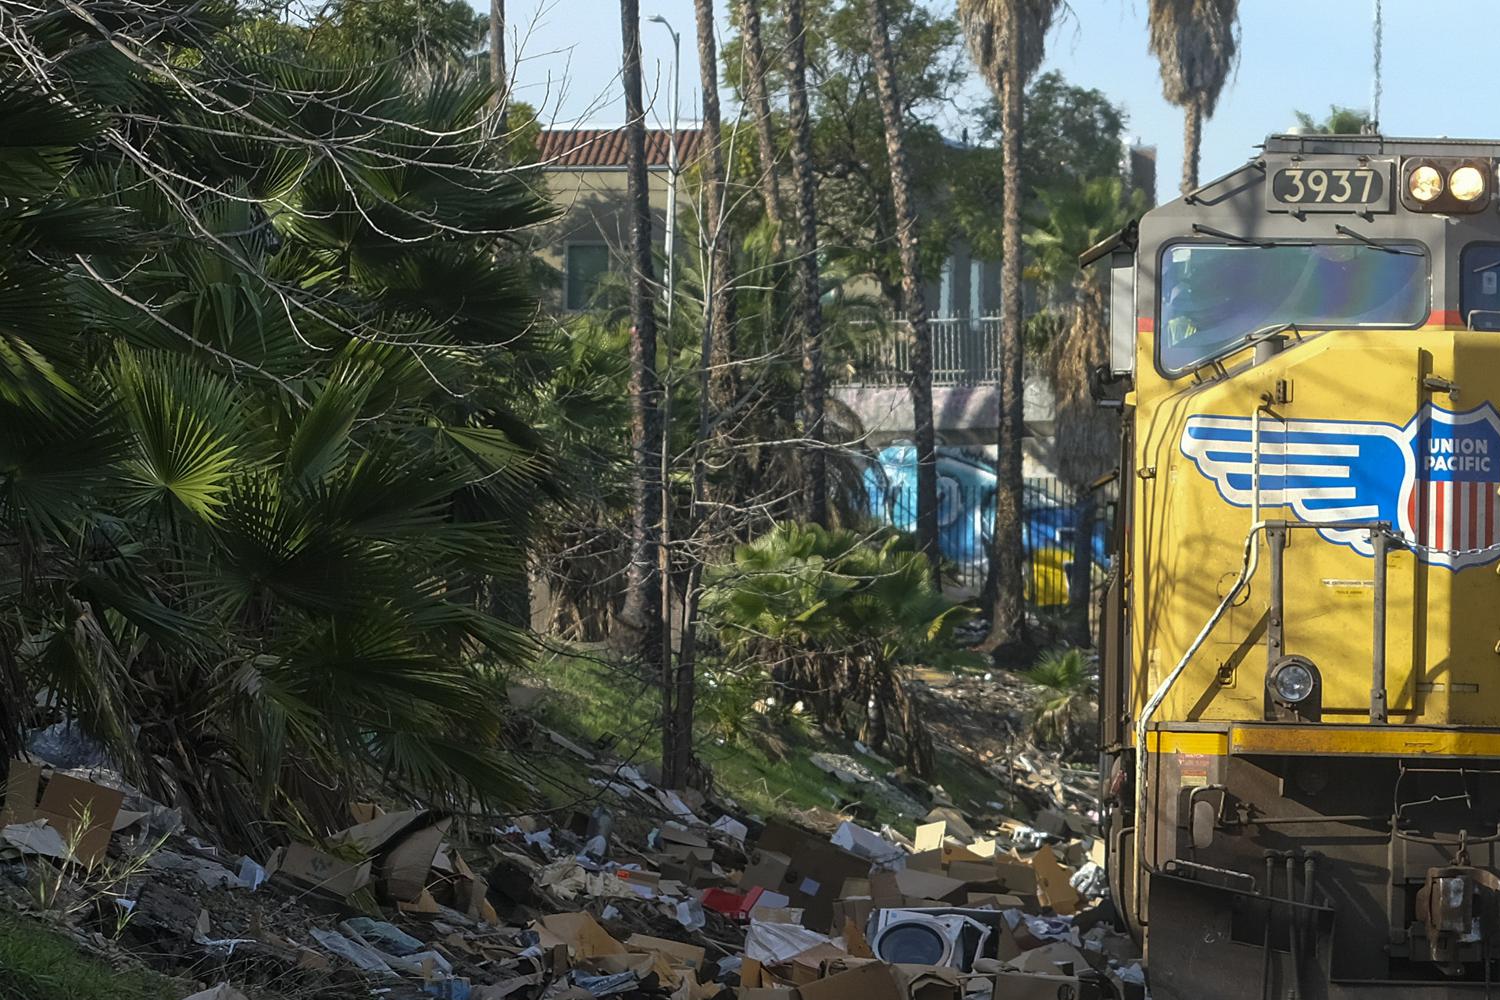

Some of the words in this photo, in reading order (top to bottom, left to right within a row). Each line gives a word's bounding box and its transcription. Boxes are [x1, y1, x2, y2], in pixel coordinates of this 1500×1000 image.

[1284, 169, 1374, 203] 3937
[1428, 438, 1488, 454] UNION
[1424, 456, 1491, 472] PACIFIC
